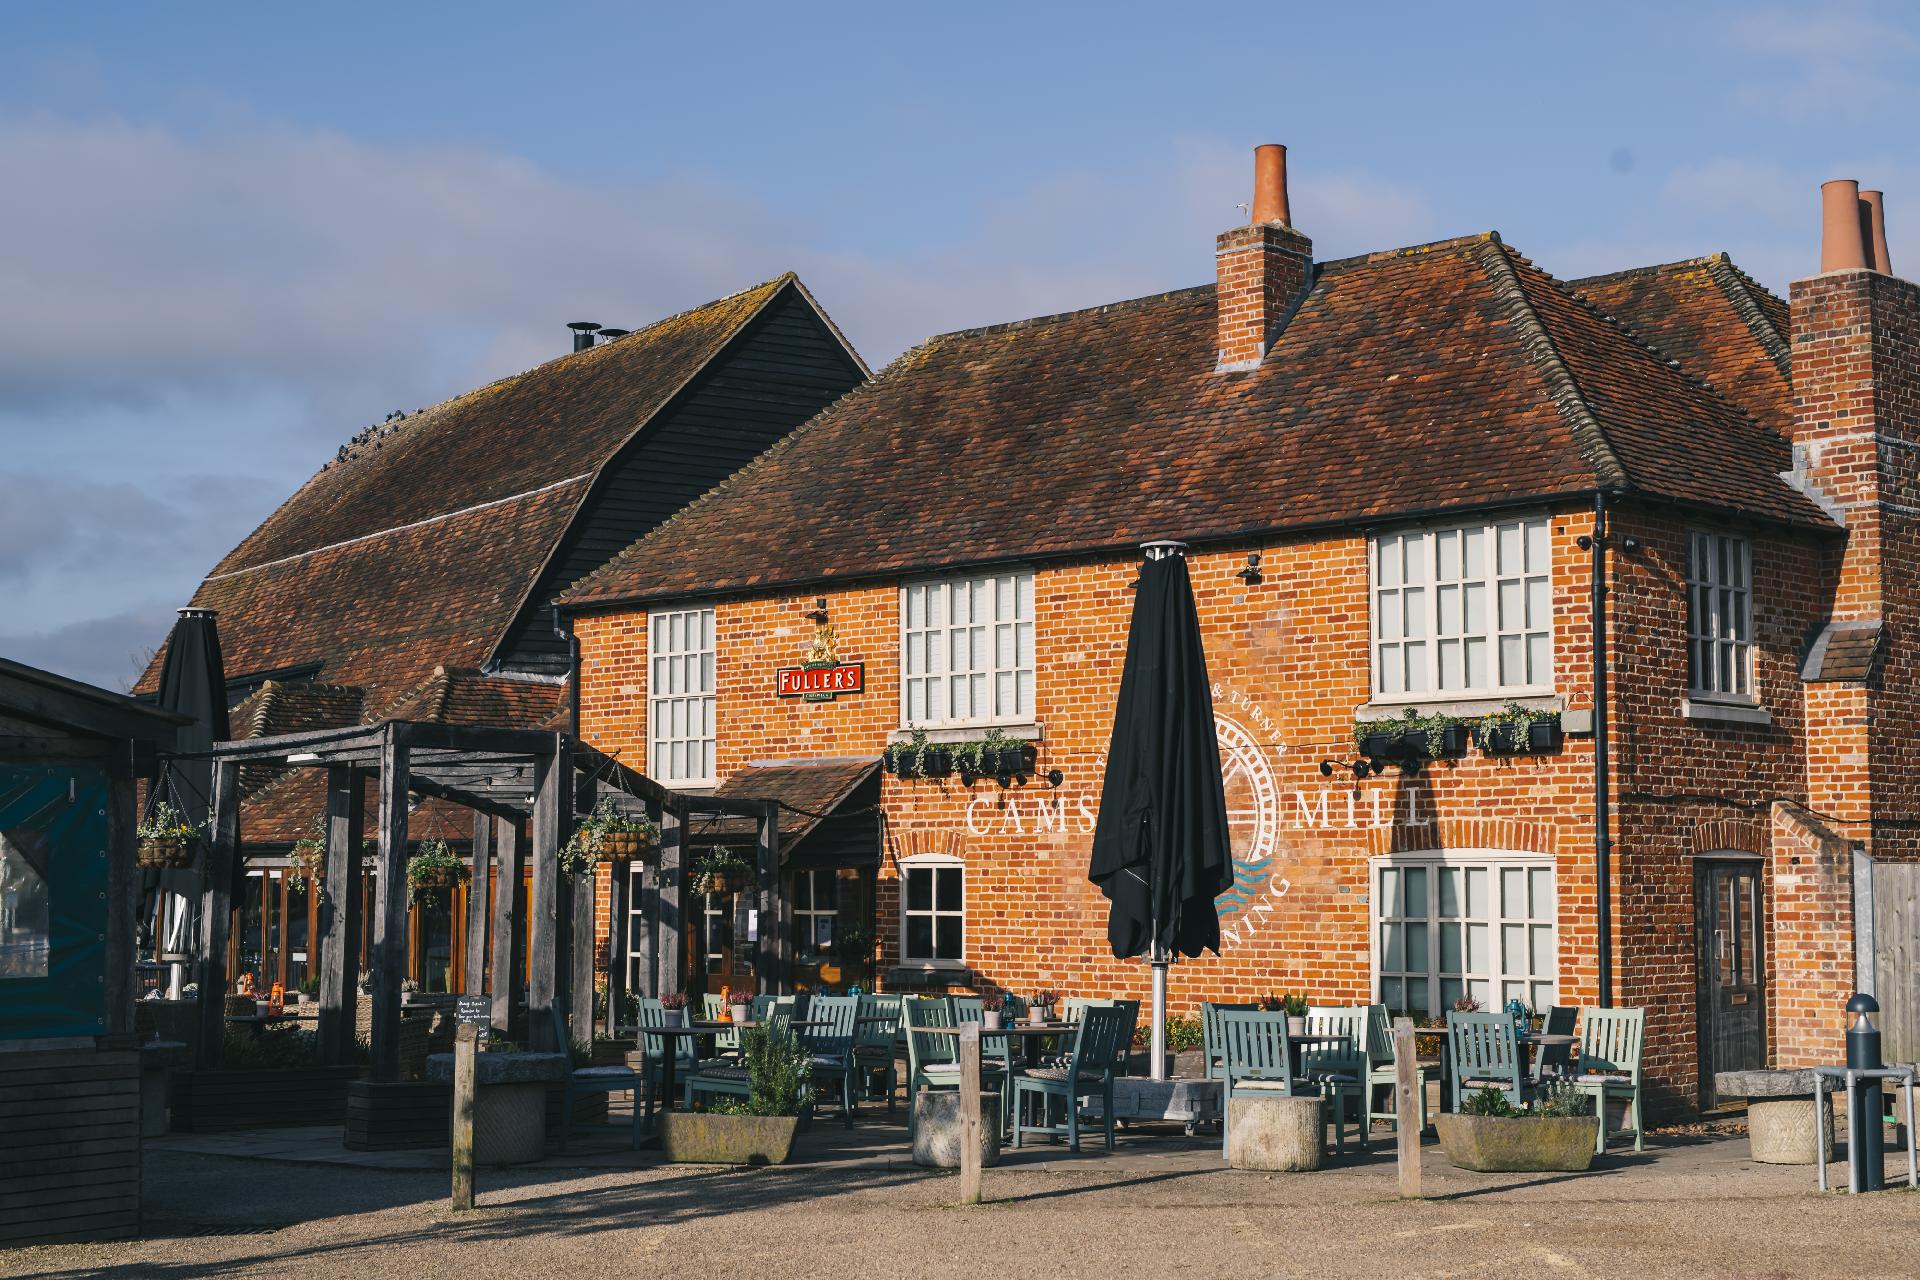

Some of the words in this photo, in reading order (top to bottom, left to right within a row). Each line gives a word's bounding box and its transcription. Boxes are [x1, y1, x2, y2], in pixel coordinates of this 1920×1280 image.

[781, 669, 855, 691] FULLER'S
[1230, 690, 1288, 757] TURNER
[966, 795, 1096, 835] CAMS
[1293, 787, 1430, 828] MILL
[1219, 873, 1291, 951] NING
